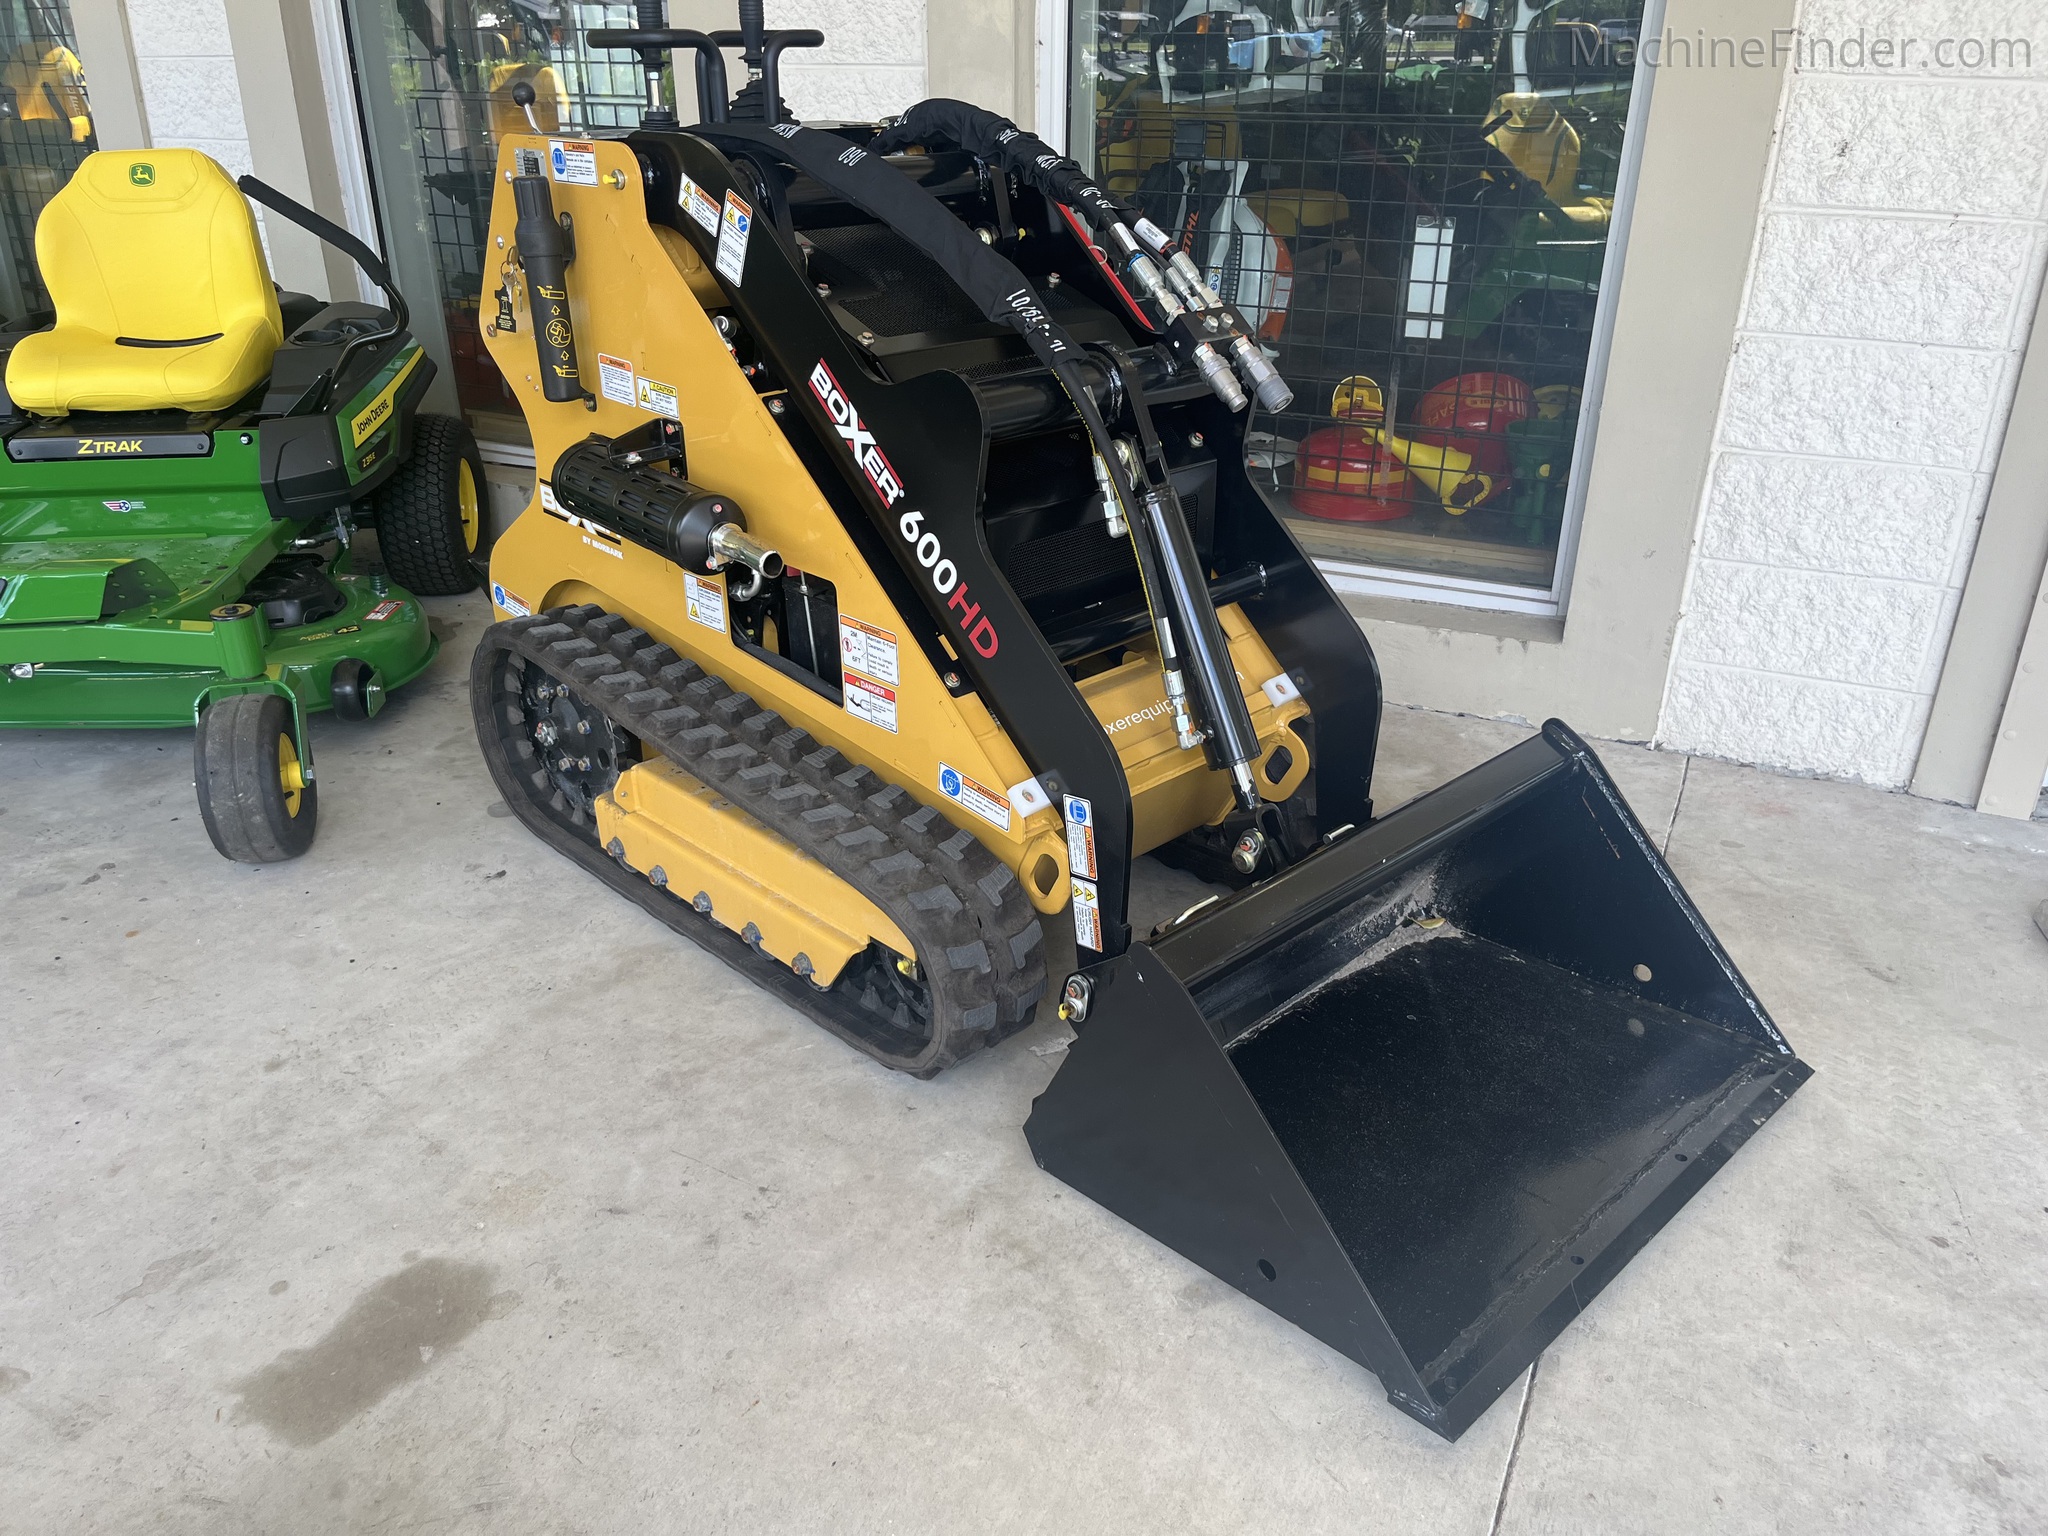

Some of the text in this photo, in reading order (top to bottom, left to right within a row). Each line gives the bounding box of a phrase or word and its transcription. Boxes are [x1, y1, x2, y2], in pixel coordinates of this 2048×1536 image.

[656, 385, 674, 395] CAUTION
[357, 399, 389, 435] JOHN DEERE
[78, 439, 143, 455] ZTRAK
[810, 362, 999, 659] BOXER 600HD
[592, 540, 624, 560] MORBARK
[850, 630, 858, 638] 2M
[860, 624, 881, 636] WARNING
[852, 655, 861, 664] 6FT
[860, 680, 885, 696] DANGER
[977, 786, 1001, 803] WARNING
[1086, 839, 1095, 873] WARNING
[1093, 917, 1101, 949] WARNING
